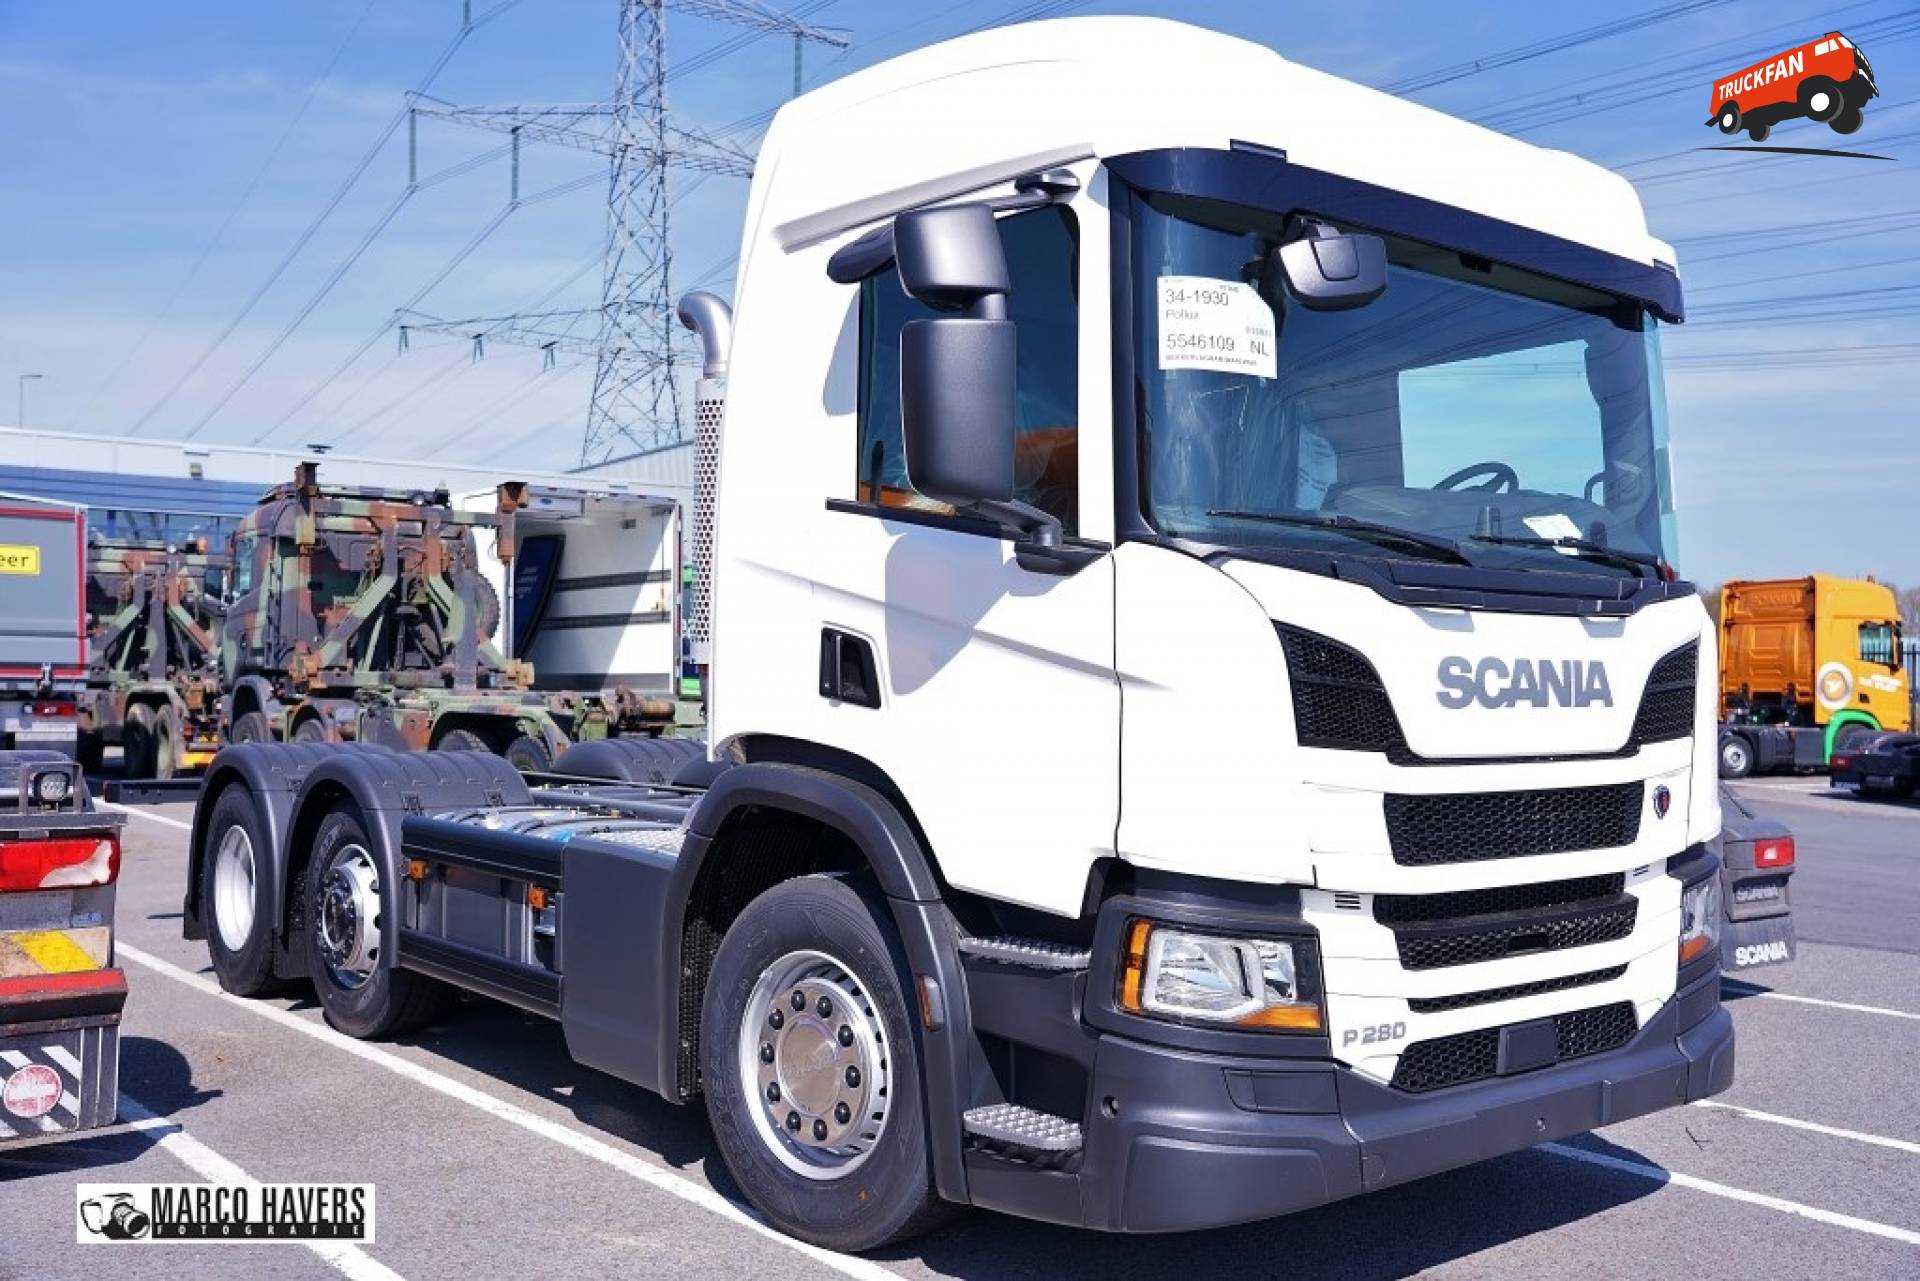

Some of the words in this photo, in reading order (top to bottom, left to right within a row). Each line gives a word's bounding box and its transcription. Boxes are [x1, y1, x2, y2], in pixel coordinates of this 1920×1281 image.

[1165, 288, 1229, 306] 34-1930
[1167, 333, 1235, 351] 5546109
[1250, 340, 1270, 356] NL
[1436, 656, 1614, 710] SCANIA
[1735, 940, 1789, 967] SCANIA
[1342, 1029, 1359, 1048] P
[1361, 1021, 1407, 1045] 280
